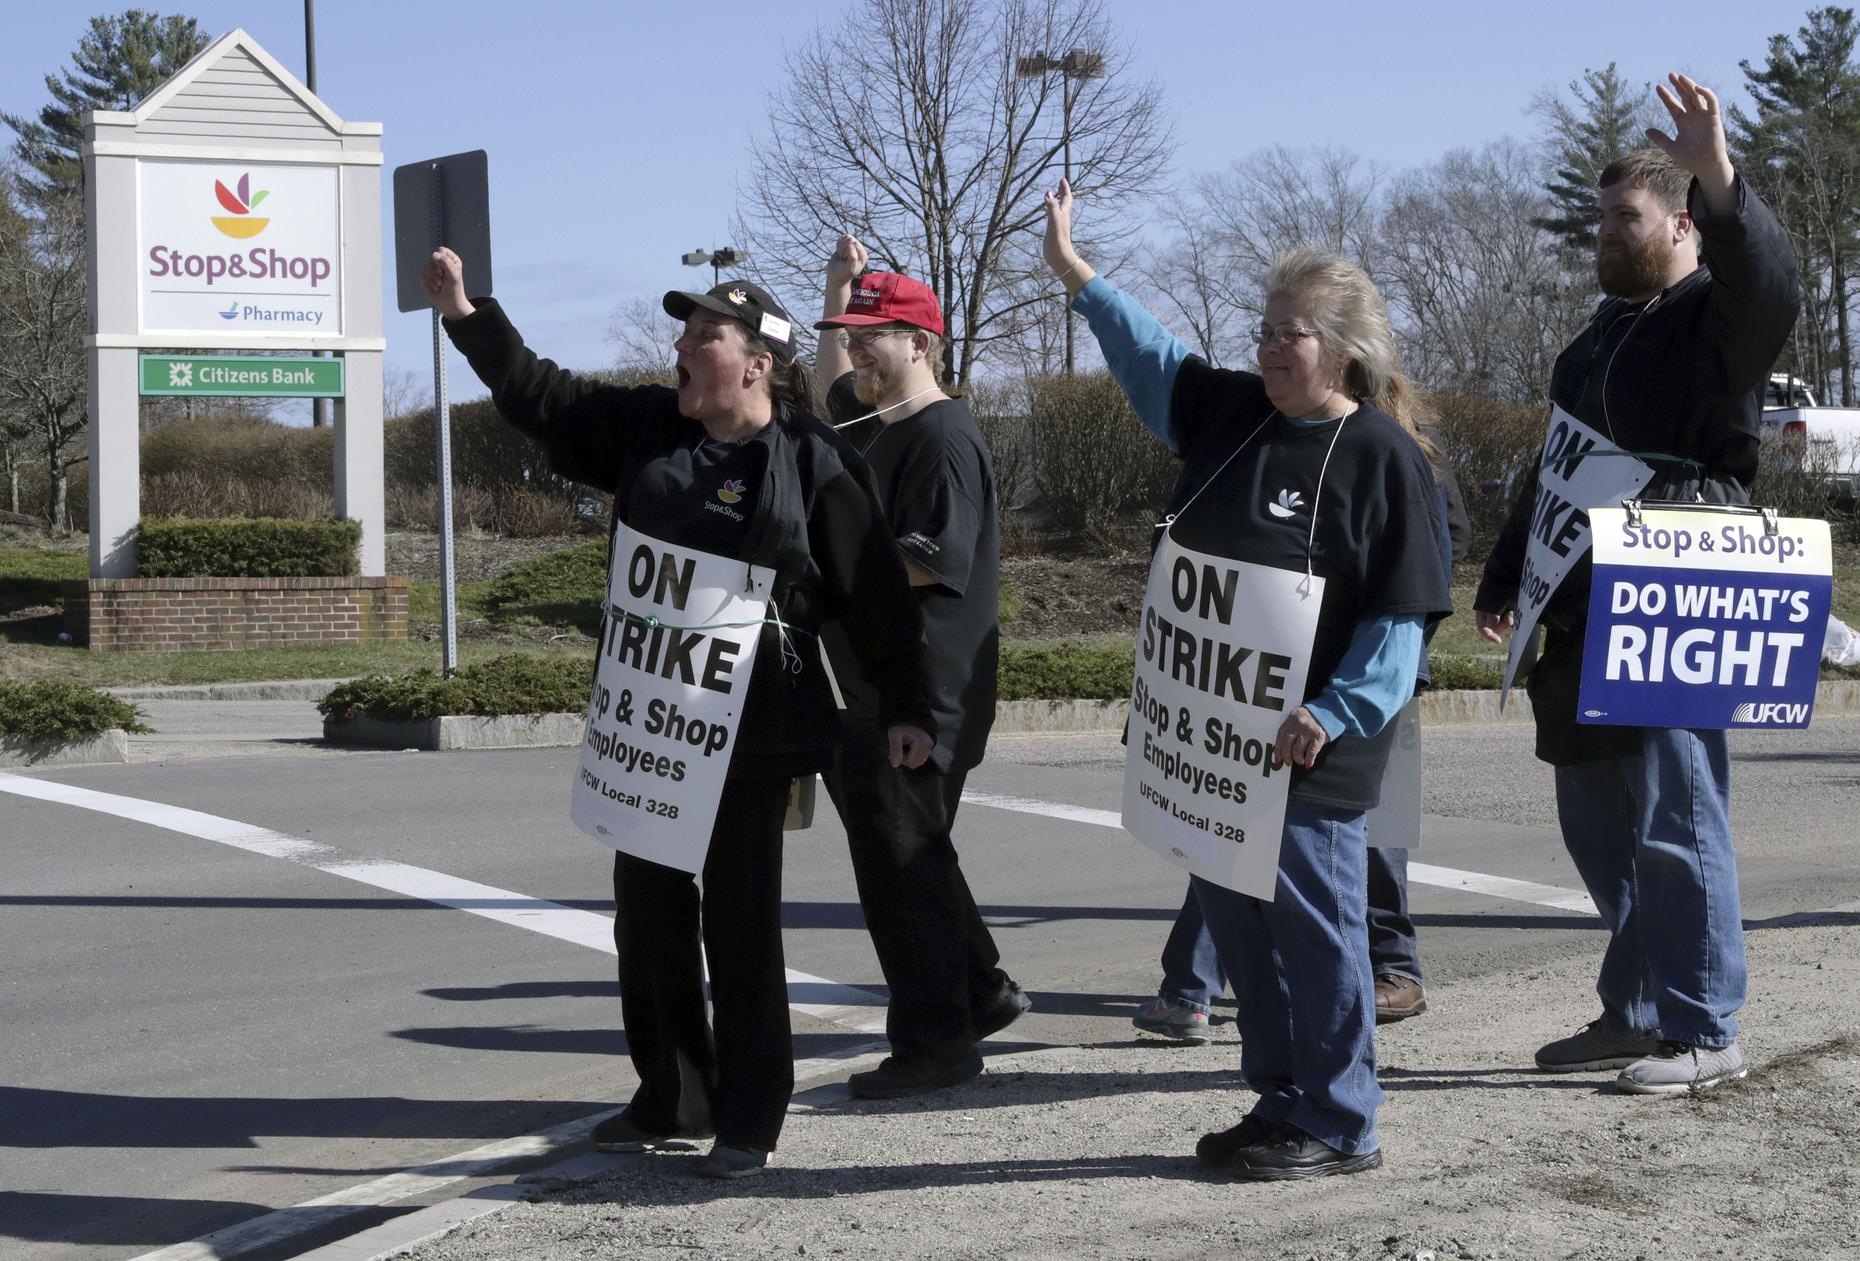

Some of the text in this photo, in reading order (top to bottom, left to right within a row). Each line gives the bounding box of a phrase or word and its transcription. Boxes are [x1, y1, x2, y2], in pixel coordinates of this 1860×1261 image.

[149, 245, 331, 287] Stop&Shop
[243, 306, 323, 325] Pharmacy
[199, 367, 315, 385] Citizens Bank
[1544, 421, 1596, 482] ON
[1622, 521, 1804, 563] Stop & Shop:
[628, 544, 696, 611] ON
[1172, 556, 1239, 625] ON
[1611, 581, 1810, 623] DO WHAT'S
[607, 603, 741, 695] TRIKE
[1143, 606, 1292, 712] STRIKE
[1605, 624, 1804, 687] RIGHT
[615, 689, 634, 726] &
[644, 698, 728, 757] Shop
[1134, 675, 1285, 778] Stop & Shop
[1747, 703, 1809, 723] UFCW
[588, 716, 686, 782] Employees
[1143, 731, 1247, 804] Employees
[601, 782, 642, 809] Local
[645, 799, 679, 819] 328
[1140, 781, 1245, 843] UFCW Local 328
